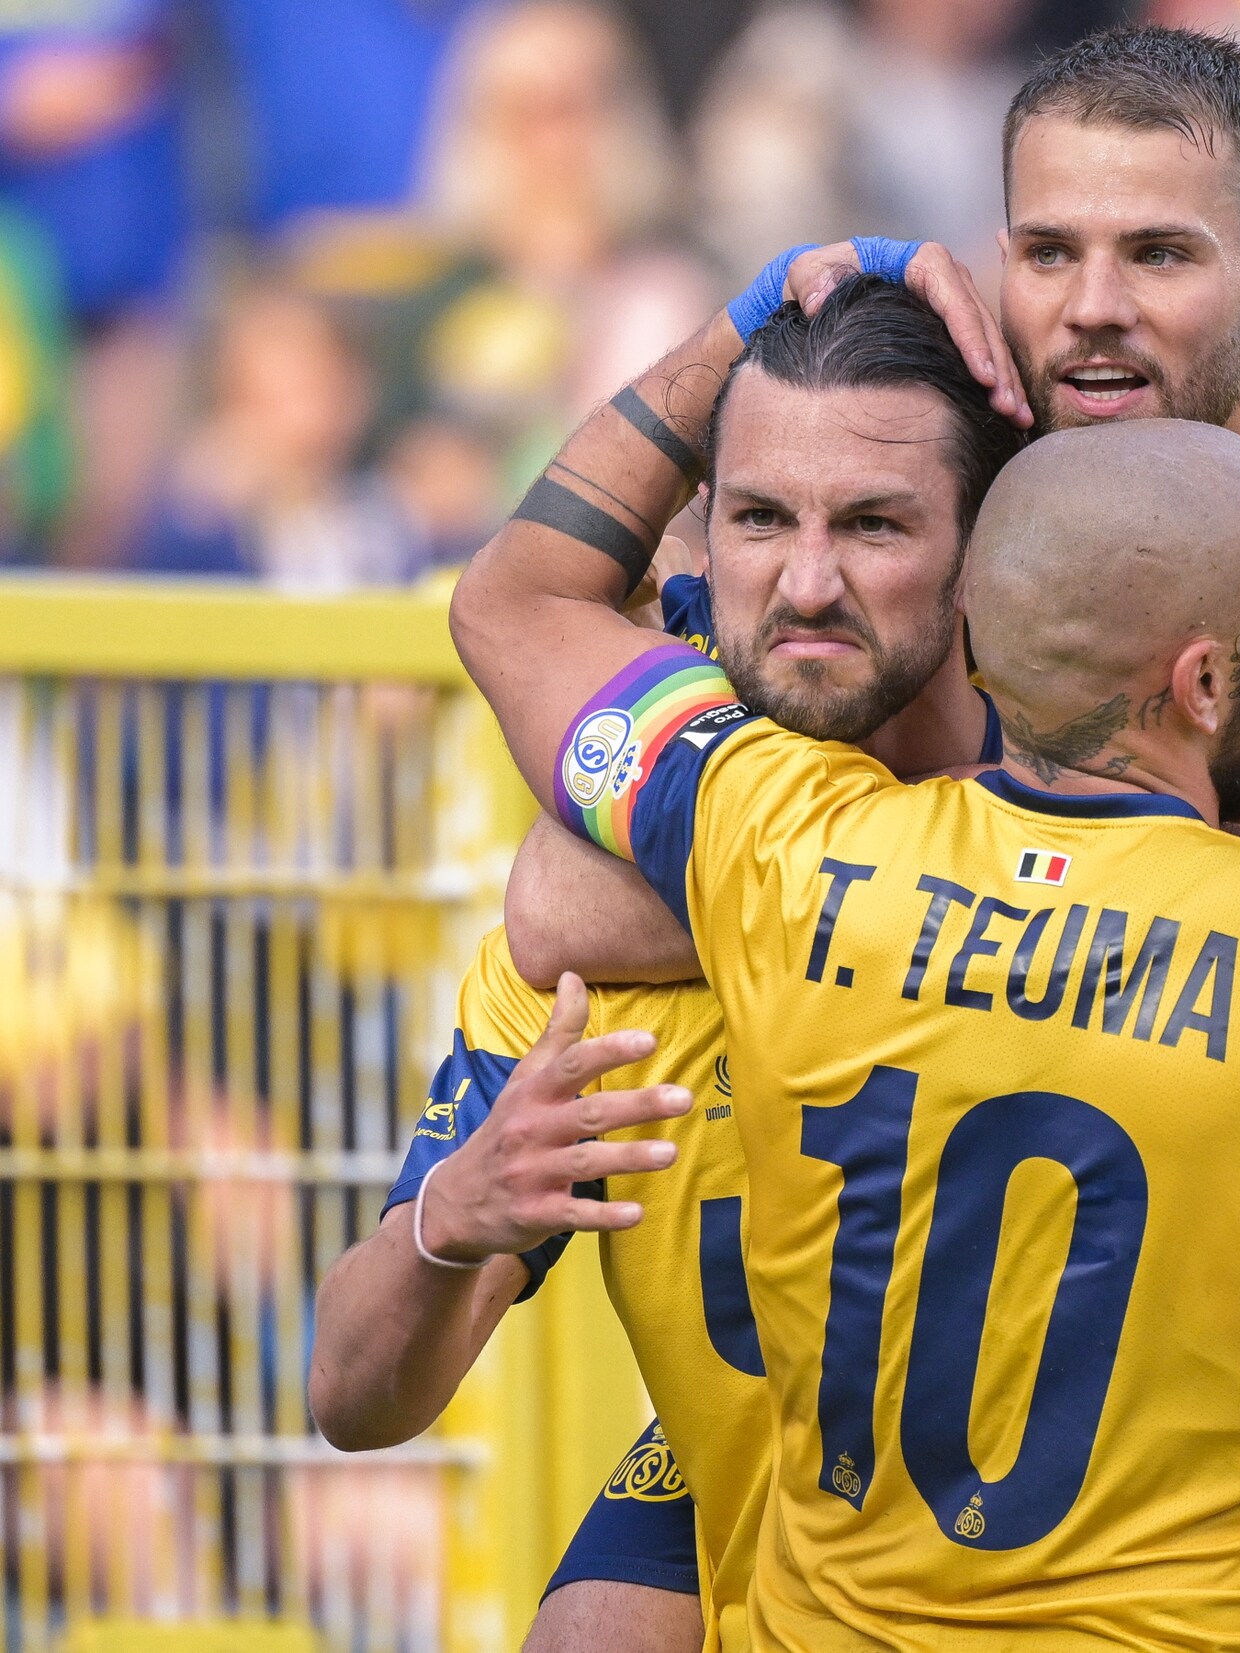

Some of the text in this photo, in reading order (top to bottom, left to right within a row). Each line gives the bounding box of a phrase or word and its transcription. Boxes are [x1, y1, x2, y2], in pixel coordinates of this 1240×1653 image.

[805, 857, 1239, 1063] T. TEUMA
[800, 1065, 1149, 1552] 10
